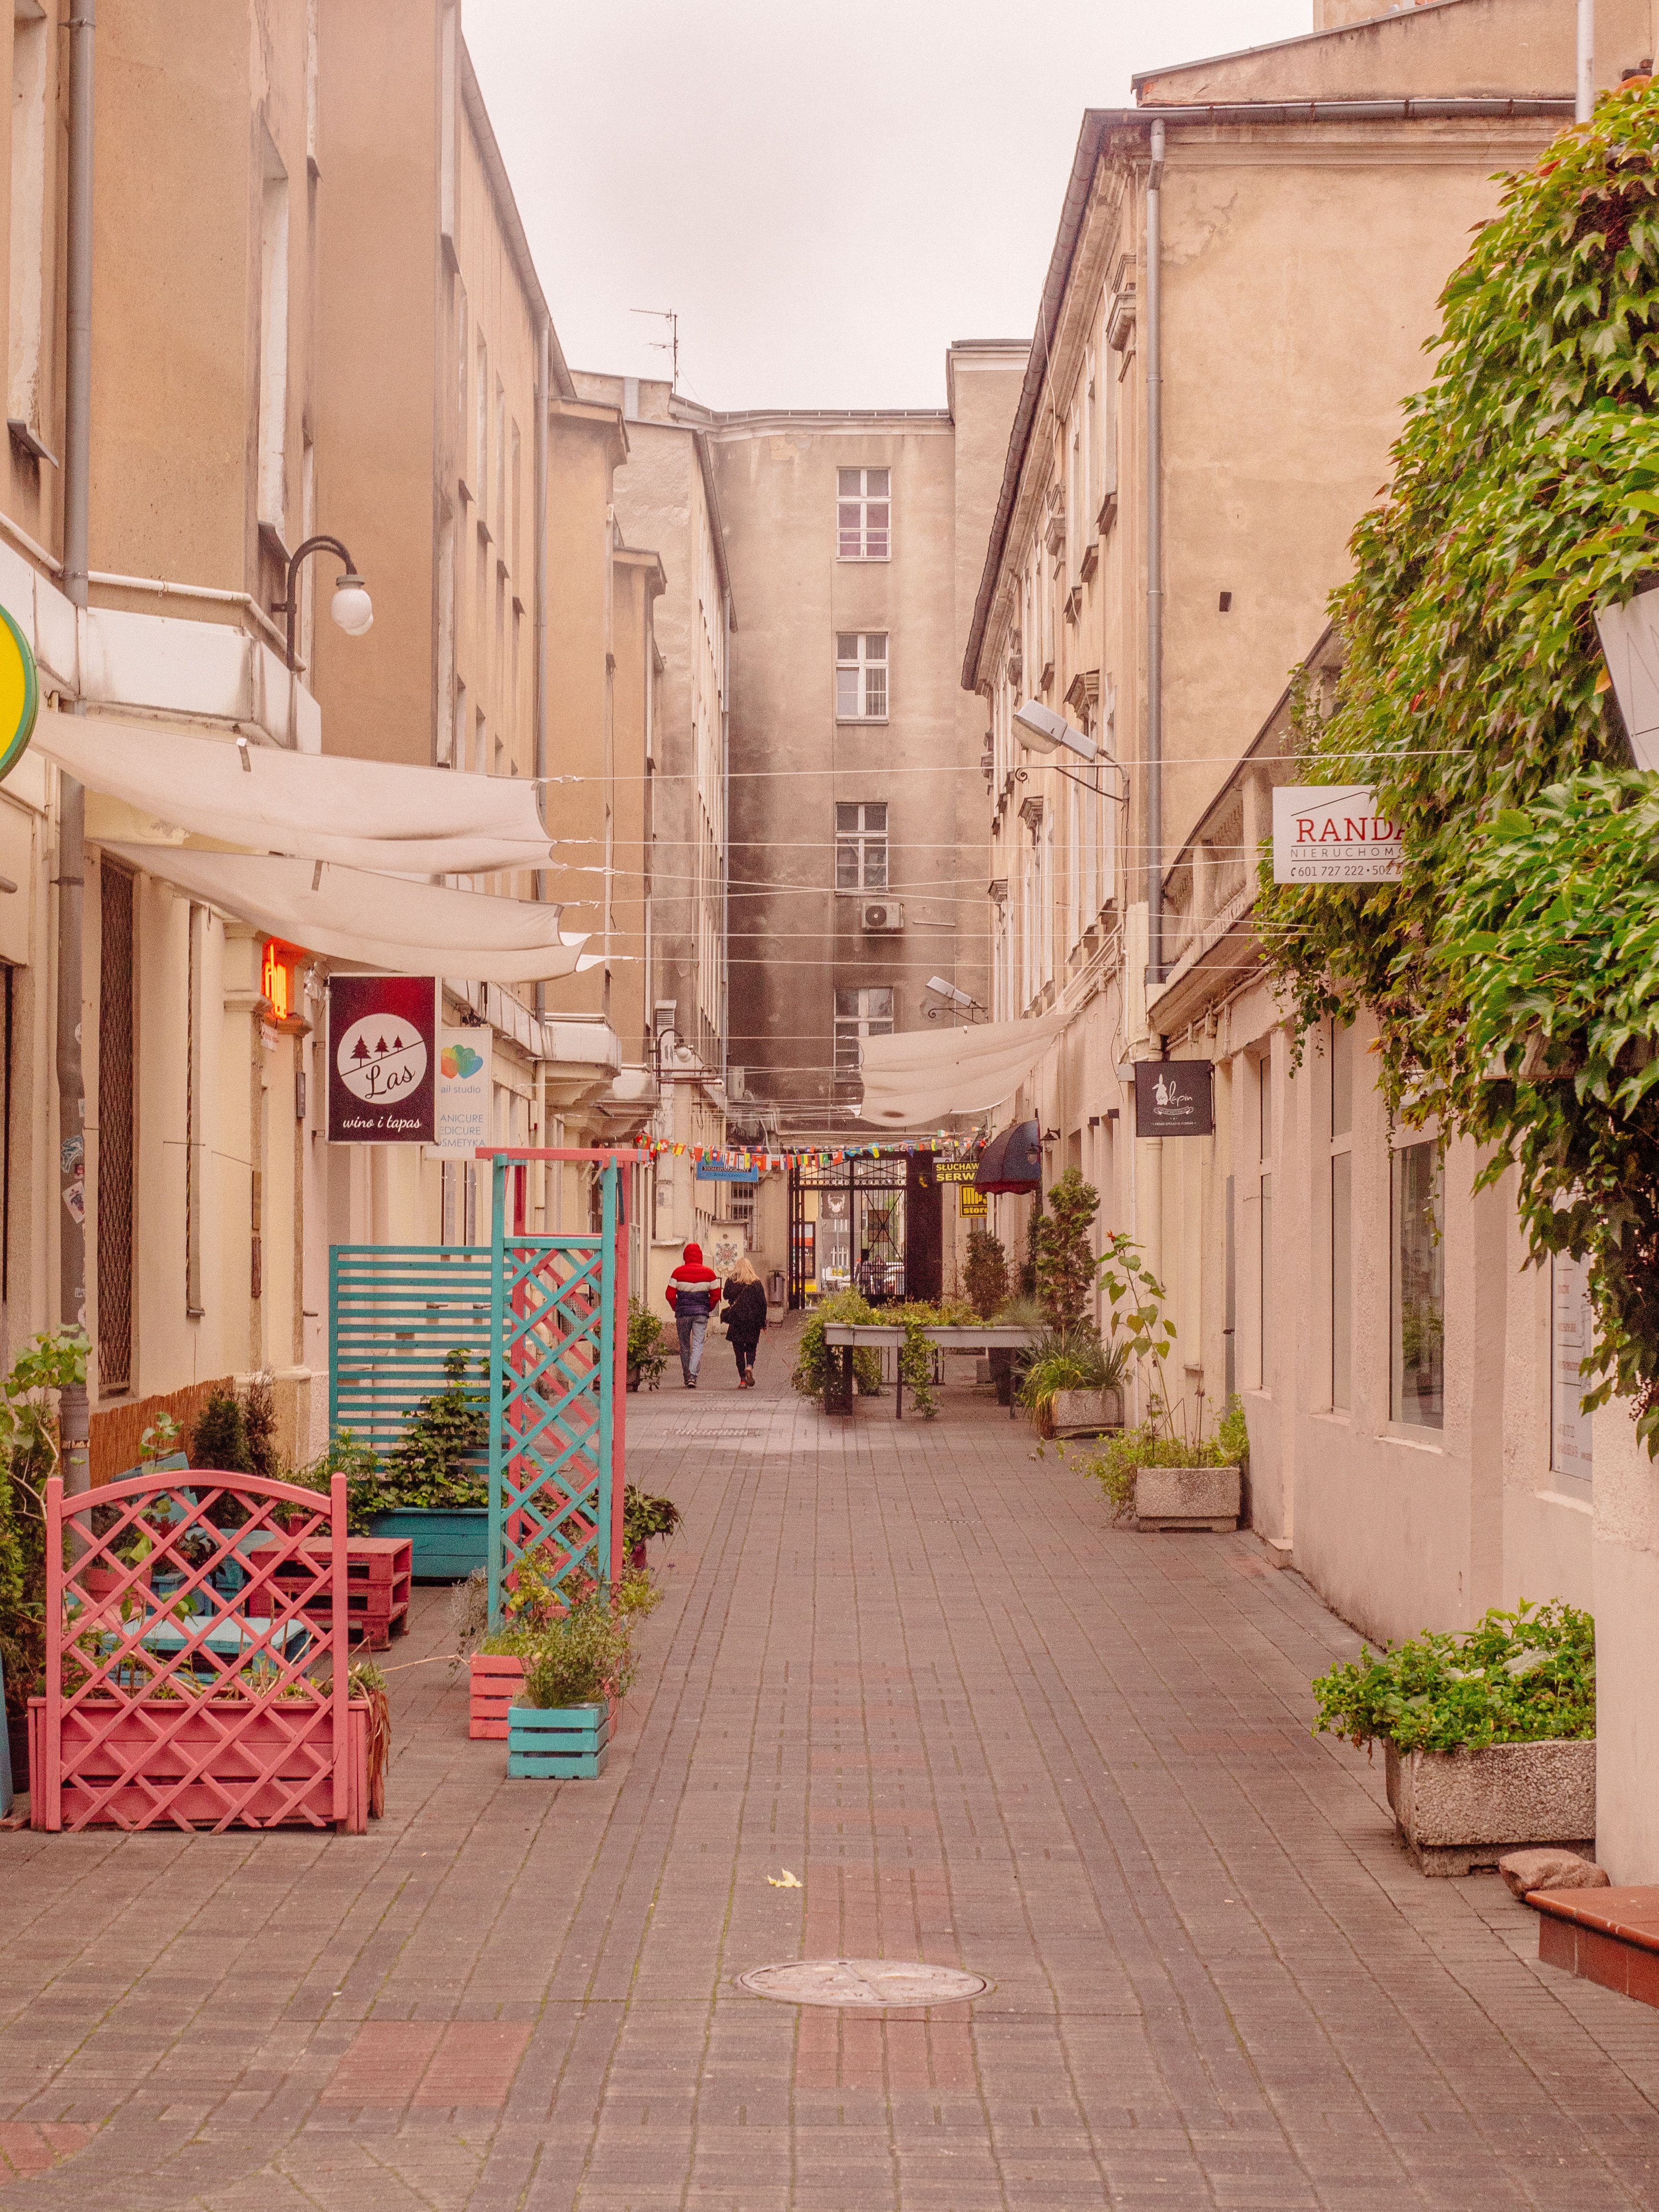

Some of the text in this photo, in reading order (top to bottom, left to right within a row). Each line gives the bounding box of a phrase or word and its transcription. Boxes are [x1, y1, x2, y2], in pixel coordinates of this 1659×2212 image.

[1298, 866, 1317, 877] 601
[1322, 866, 1340, 876] 727
[1345, 866, 1363, 876] 222
[365, 1065, 416, 1099] Las
[453, 1085, 481, 1094] studio
[1168, 1081, 1192, 1106] lapin
[343, 1114, 422, 1132] wino i tapas
[440, 1114, 484, 1123] ANICURE
[937, 1173, 975, 1181] SERW
